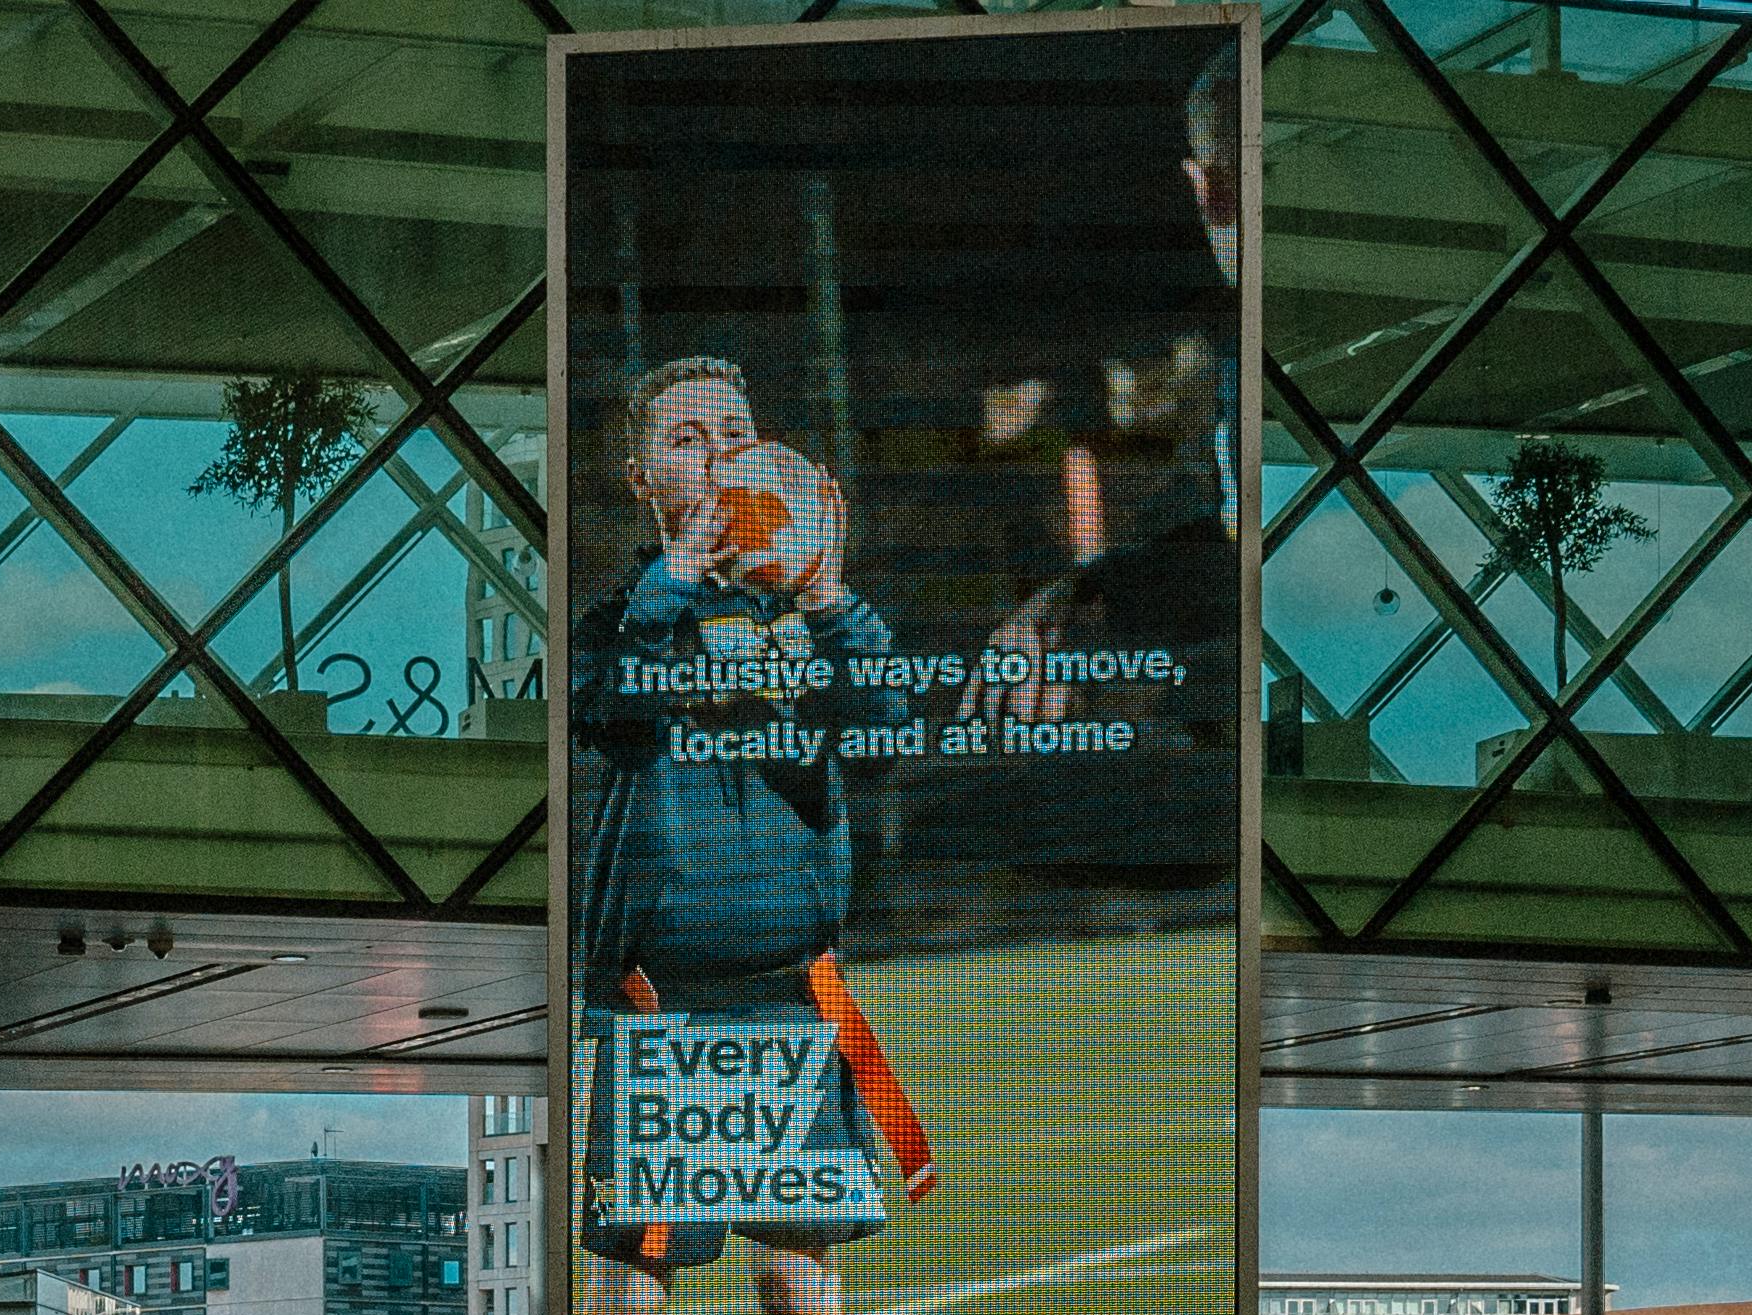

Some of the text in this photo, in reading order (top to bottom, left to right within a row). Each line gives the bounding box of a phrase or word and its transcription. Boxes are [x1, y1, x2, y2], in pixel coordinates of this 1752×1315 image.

[618, 647, 1188, 694] Inclusive ways to move,
[669, 715, 1136, 766] locally and at home
[628, 1028, 813, 1087] Every
[628, 1092, 795, 1152] Body
[628, 1156, 864, 1206] Moves.
